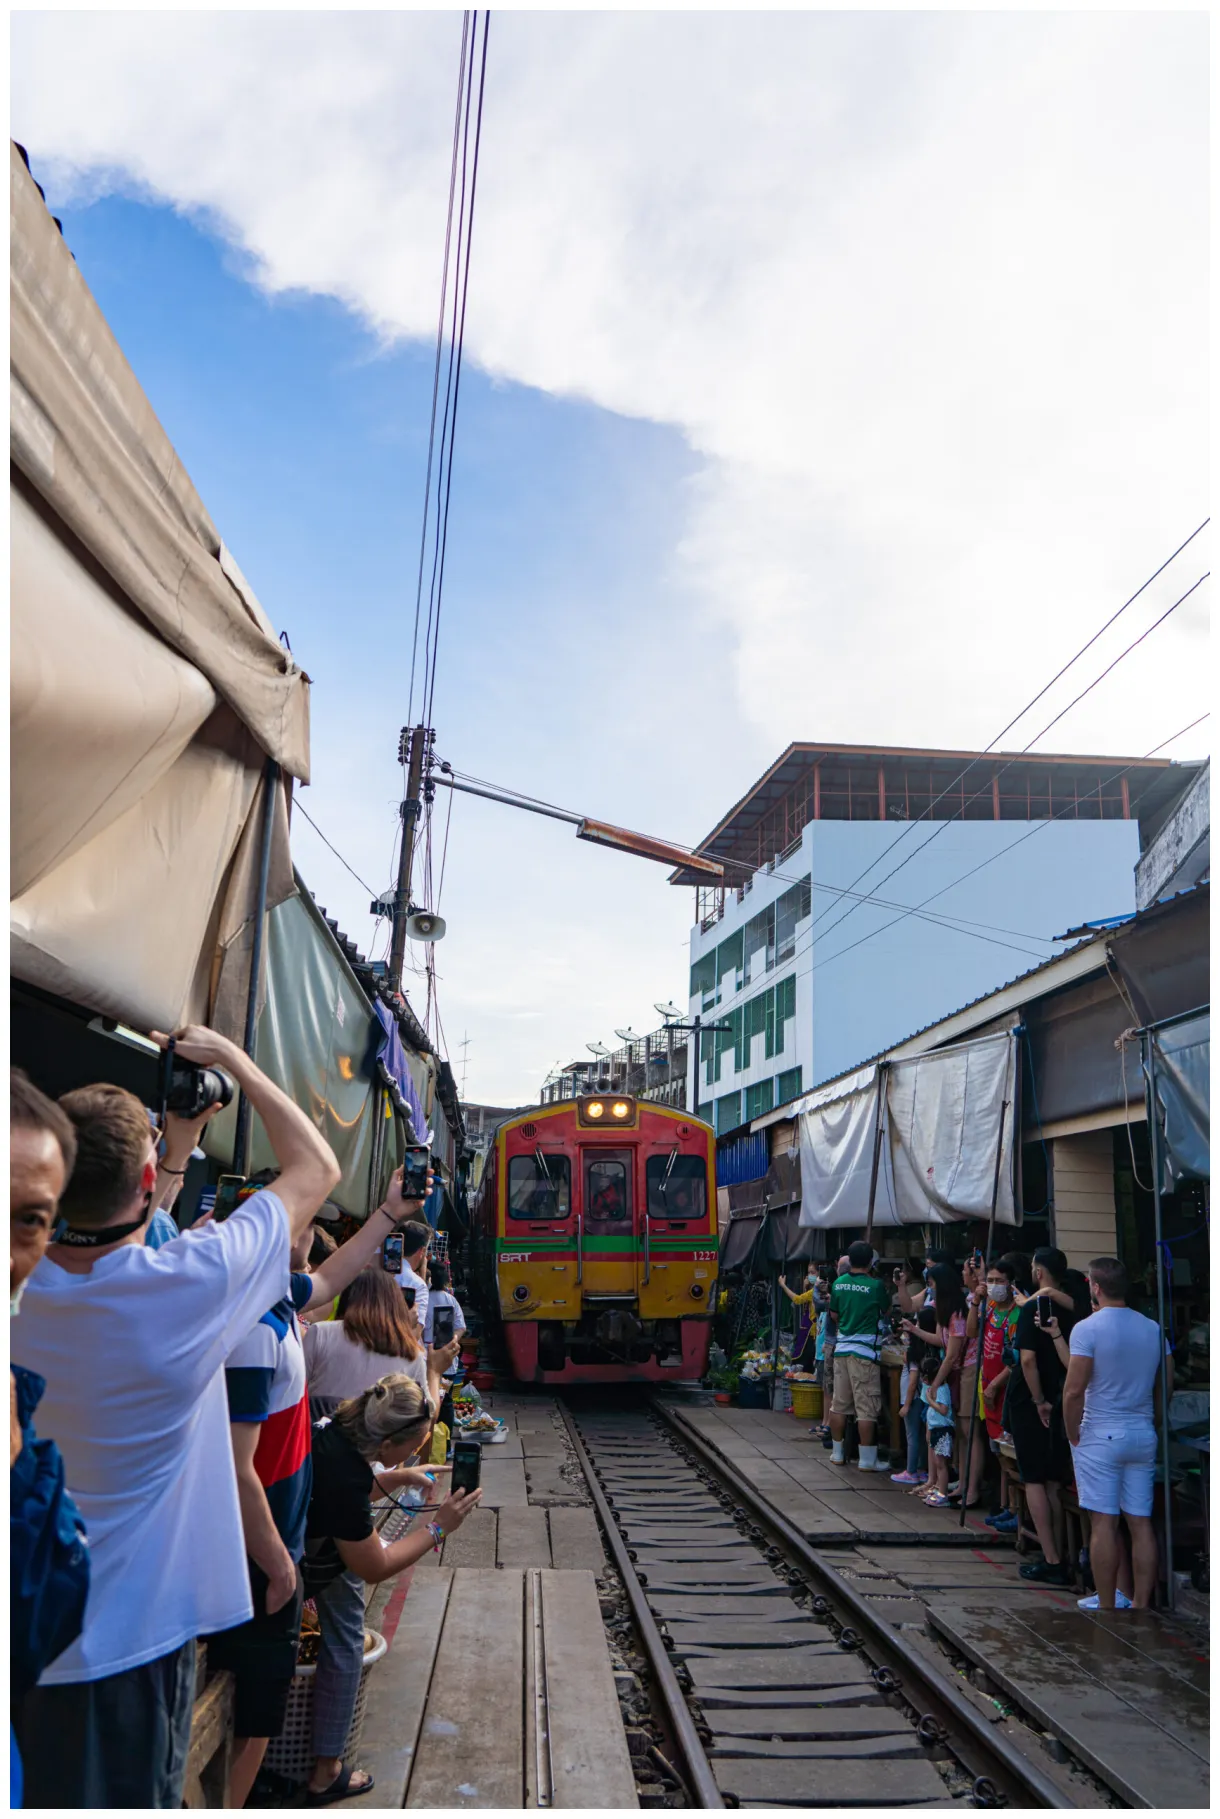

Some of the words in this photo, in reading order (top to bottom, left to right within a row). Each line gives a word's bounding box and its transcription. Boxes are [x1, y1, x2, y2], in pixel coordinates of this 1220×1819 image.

[62, 1231, 97, 1243] SONY
[500, 1252, 532, 1263] SRT
[693, 1251, 716, 1261] 1227
[835, 1283, 851, 1291] SUPER
[851, 1284, 870, 1294] BOCK
